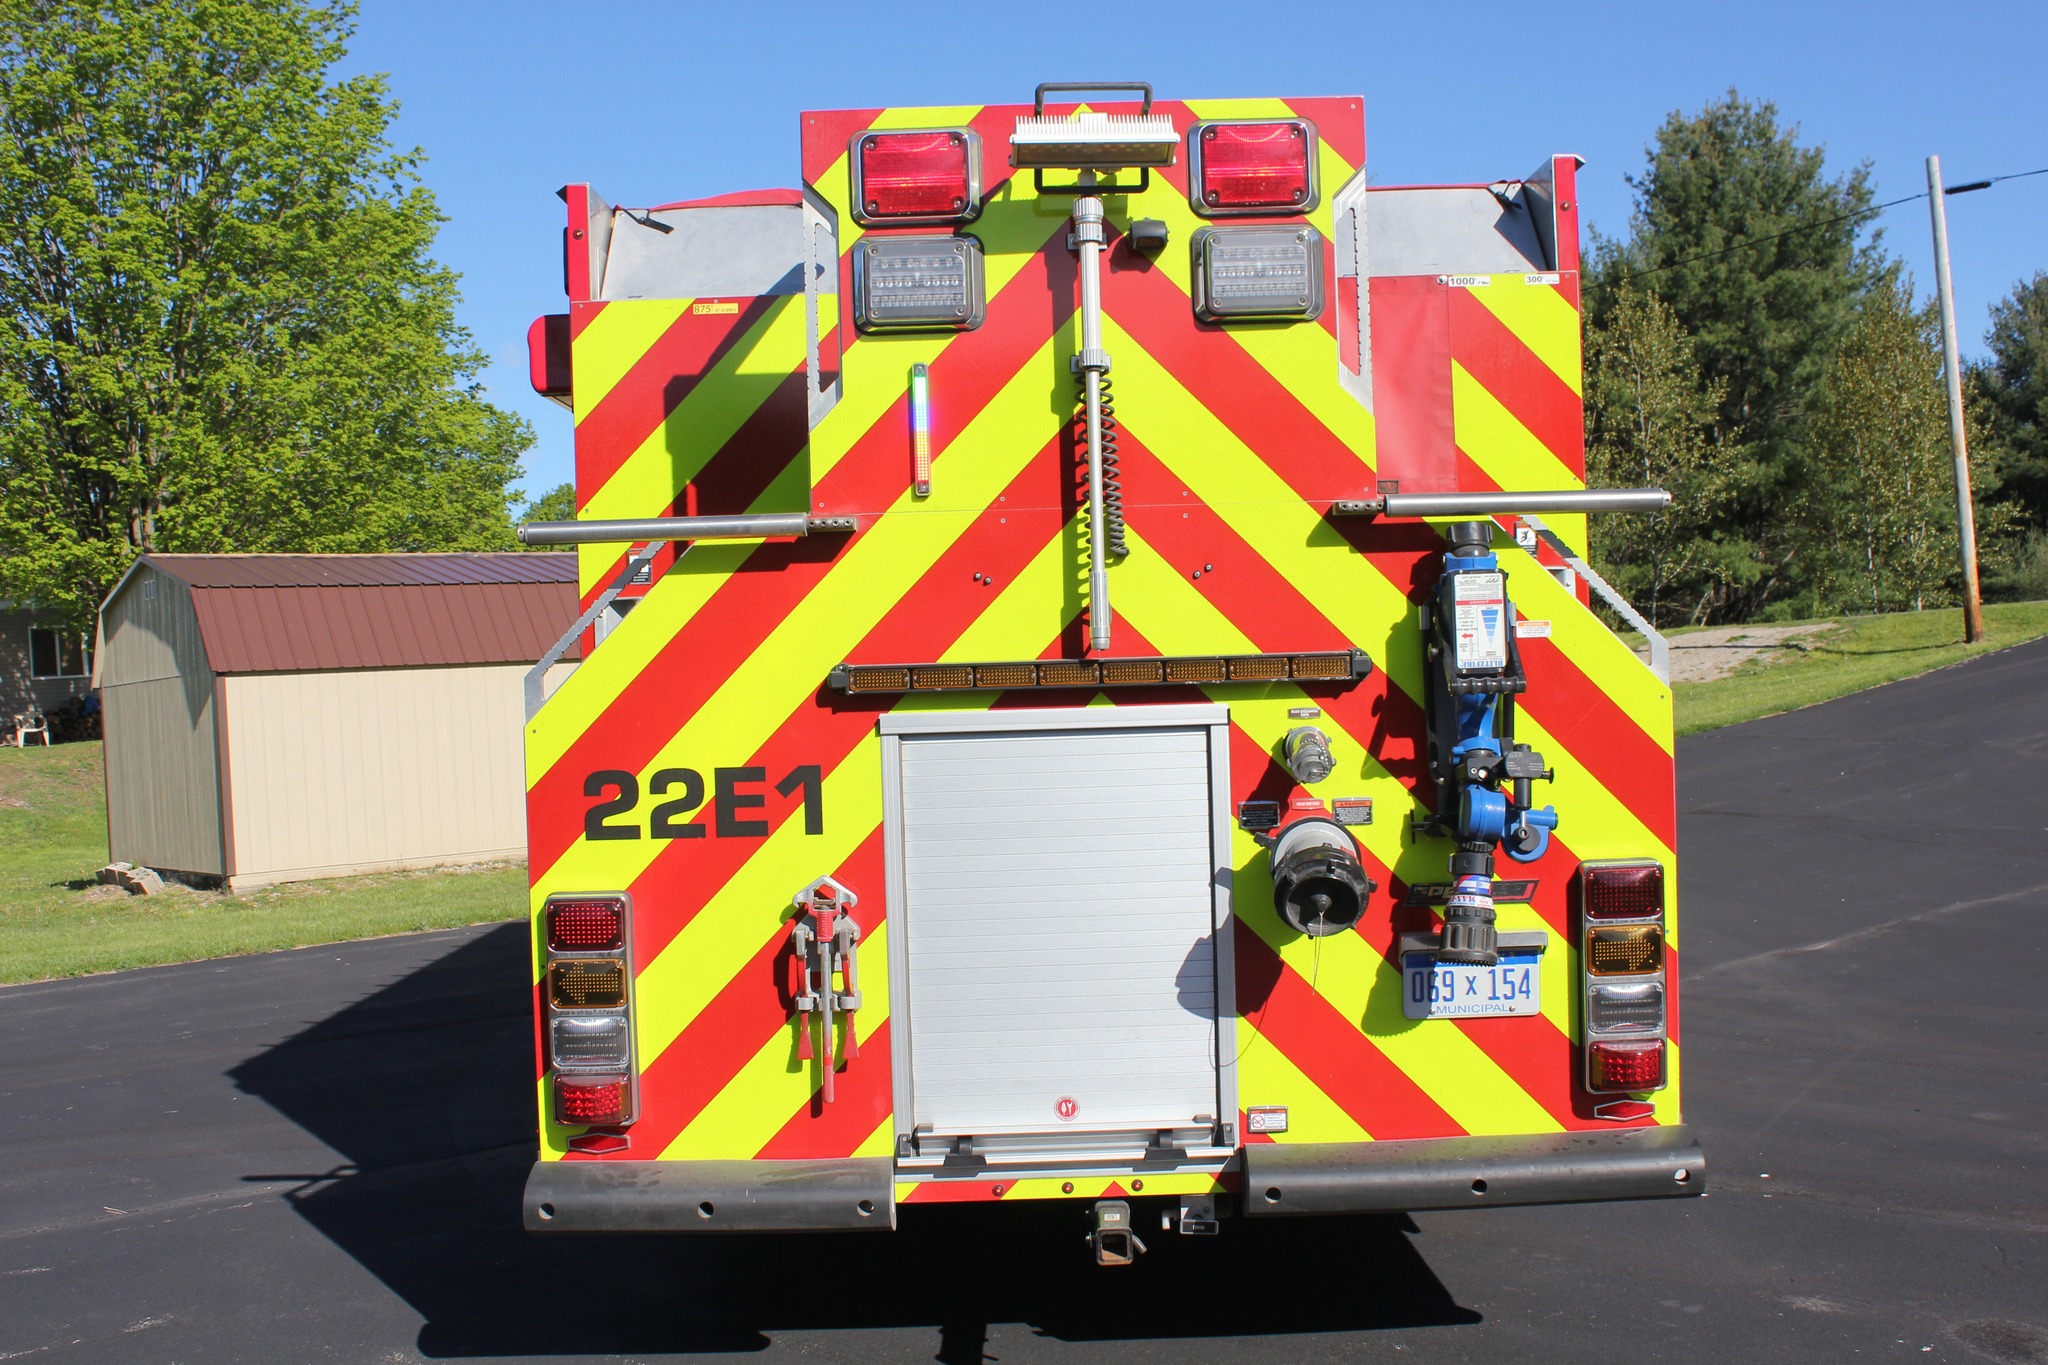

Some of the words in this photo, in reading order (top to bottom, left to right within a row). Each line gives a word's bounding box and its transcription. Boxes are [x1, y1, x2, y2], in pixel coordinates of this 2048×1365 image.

[583, 765, 823, 841] 22E1
[1412, 971, 1455, 1003] 069
[1488, 968, 1531, 1000] 154
[1436, 1003, 1509, 1015] MUNICIPAL
